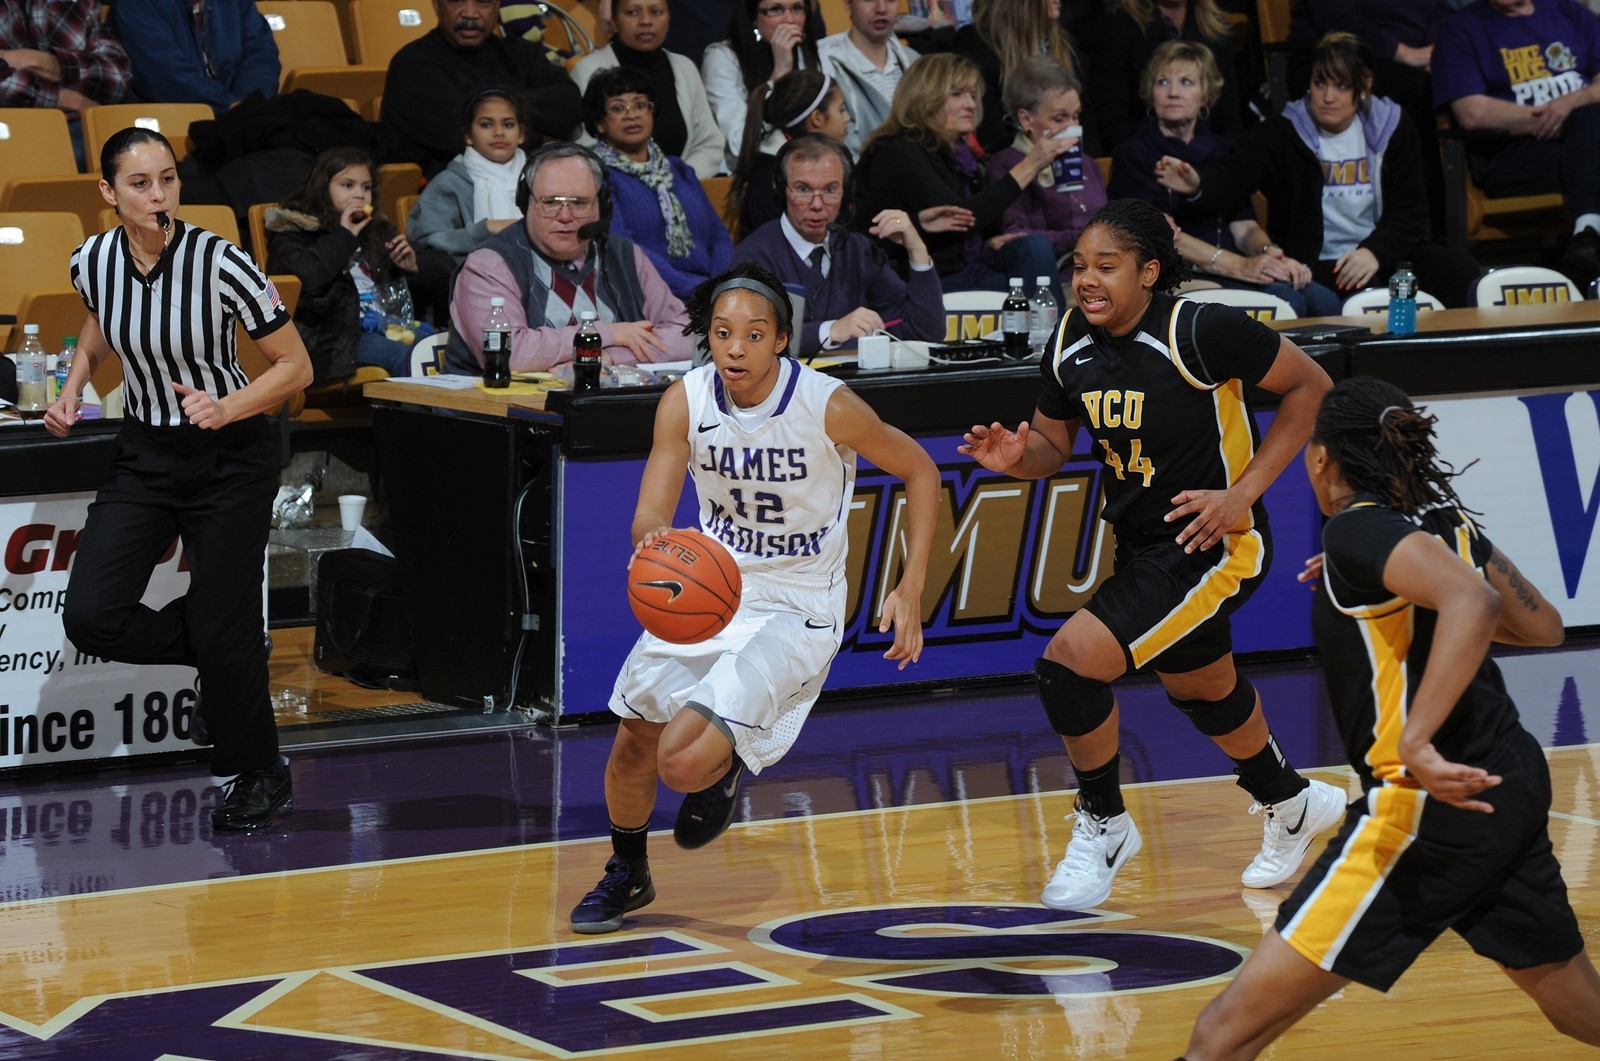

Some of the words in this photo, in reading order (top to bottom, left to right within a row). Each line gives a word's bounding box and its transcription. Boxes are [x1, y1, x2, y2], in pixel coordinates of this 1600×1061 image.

[943, 314, 1003, 342] JM
[1081, 389, 1145, 430] VCU
[701, 445, 808, 482] JAMES
[1098, 438, 1155, 488] 44
[729, 487, 786, 524] 12
[704, 498, 829, 558] MADISON
[651, 540, 698, 566] ELITE
[114, 688, 198, 746] 186
